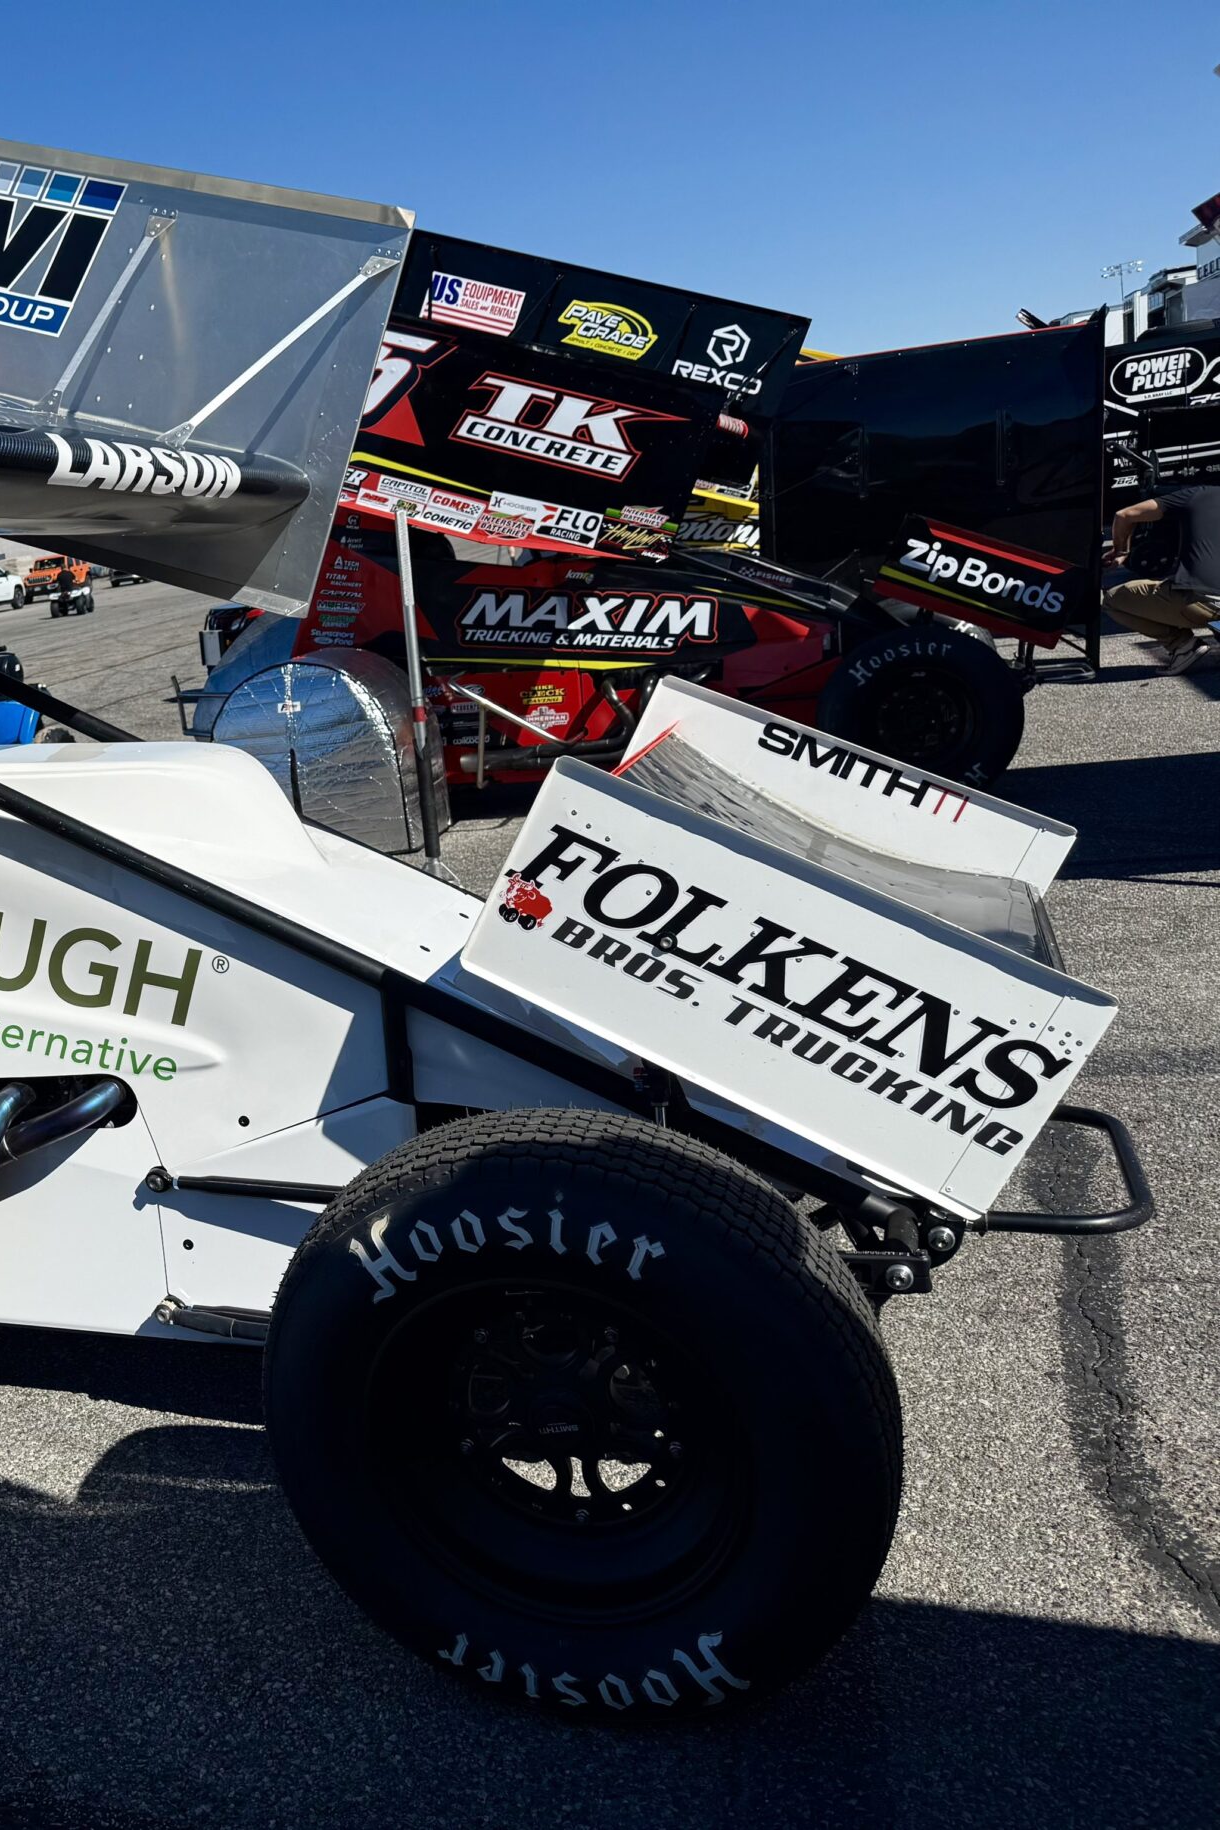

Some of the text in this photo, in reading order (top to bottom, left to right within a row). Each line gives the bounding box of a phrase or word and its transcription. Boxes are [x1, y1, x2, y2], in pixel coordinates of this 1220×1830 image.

[463, 281, 524, 309] EQUIPMENT
[460, 297, 480, 311] SALES
[489, 306, 518, 320] RENTALS
[565, 305, 623, 327] PAVE
[578, 319, 649, 349] GRADE
[1124, 352, 1192, 379] POWER
[1131, 369, 1182, 392] PLUS!
[466, 420, 624, 472] CONCRETE
[45, 432, 242, 499] LARSON
[381, 477, 429, 496] CAPITOL
[432, 495, 471, 512] COMP
[502, 501, 538, 513] HOOSIER
[623, 507, 669, 523] INTERSTATE
[423, 511, 473, 531] COMETIC
[480, 514, 534, 533] INTERSTATE
[480, 522, 526, 538] BATTERIES
[554, 508, 601, 533] FLO
[622, 513, 662, 527] BATTERIES
[549, 527, 581, 541] RACING
[461, 592, 712, 637] MAXIM
[464, 629, 677, 649] TRUCKING & MATERIALS
[848, 637, 953, 687] Hoosier
[507, 824, 1075, 1110] FOLKENS
[550, 916, 1025, 1157] BROS. TRUCKING
[348, 1189, 666, 1304] Hoosier
